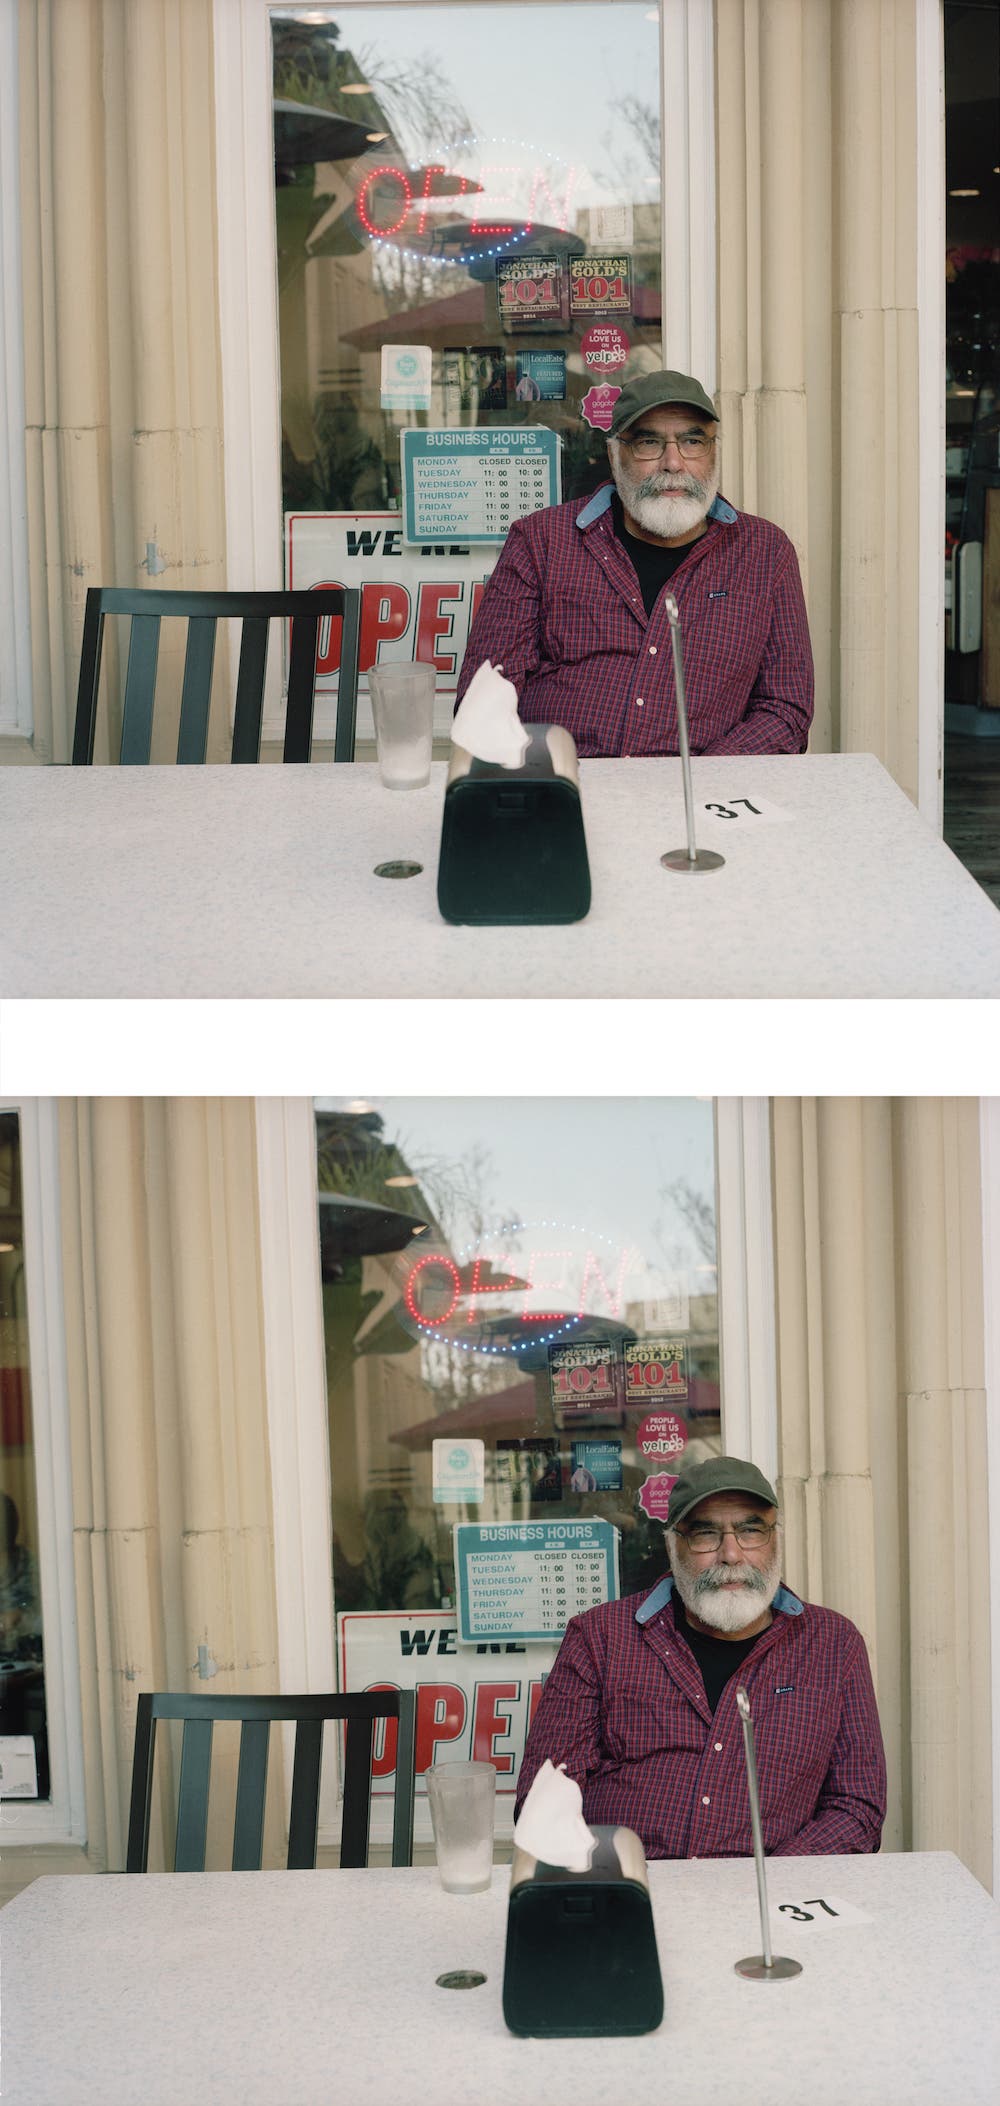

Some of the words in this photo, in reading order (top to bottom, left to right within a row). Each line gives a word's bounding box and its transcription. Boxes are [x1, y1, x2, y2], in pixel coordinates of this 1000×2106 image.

[357, 166, 575, 235] OPEN
[500, 261, 556, 270] JONATHAN
[572, 260, 627, 269] JONATHAN
[500, 269, 556, 280] GOLD'S
[571, 267, 628, 277] GOLD'S
[499, 279, 558, 304] 101
[572, 277, 626, 302] 101
[531, 354, 563, 363] LocalEats
[586, 350, 613, 364] yelp
[426, 433, 489, 446] BUSINESS
[492, 432, 536, 445] HOURS
[417, 458, 458, 466] MONDAY
[418, 469, 462, 477] TUESDAY
[418, 480, 478, 488] WEDNESDAY
[419, 491, 469, 499] THURSDAY
[418, 503, 452, 511] FRIDAY
[418, 514, 469, 522] SATURDAY
[705, 799, 762, 818] 37
[407, 1249, 628, 1326] OPEN
[553, 1348, 609, 1357] JONATHAN
[626, 1344, 683, 1353] JONATHAN
[553, 1355, 610, 1368] GOLD'S
[627, 1351, 684, 1363] GOLD'S
[552, 1365, 611, 1394] 101
[627, 1361, 684, 1389] 101
[586, 1445, 619, 1454] LocalEats
[642, 1440, 670, 1454] yelp
[480, 1527, 544, 1541] BUSINESS
[548, 1526, 593, 1539] HOURS
[471, 1554, 512, 1562] MONDAY
[534, 1553, 567, 1561] CLOSED
[571, 1552, 605, 1560] CLOSED
[472, 1565, 516, 1574] TUESDAY
[472, 1576, 533, 1585] WEDNESDAY
[473, 1588, 524, 1597] THURSDAY
[473, 1601, 507, 1609] FRIDAY
[473, 1611, 525, 1620] SATURDAY
[474, 1623, 513, 1631] SUNDAY
[779, 1899, 840, 1921] 37
